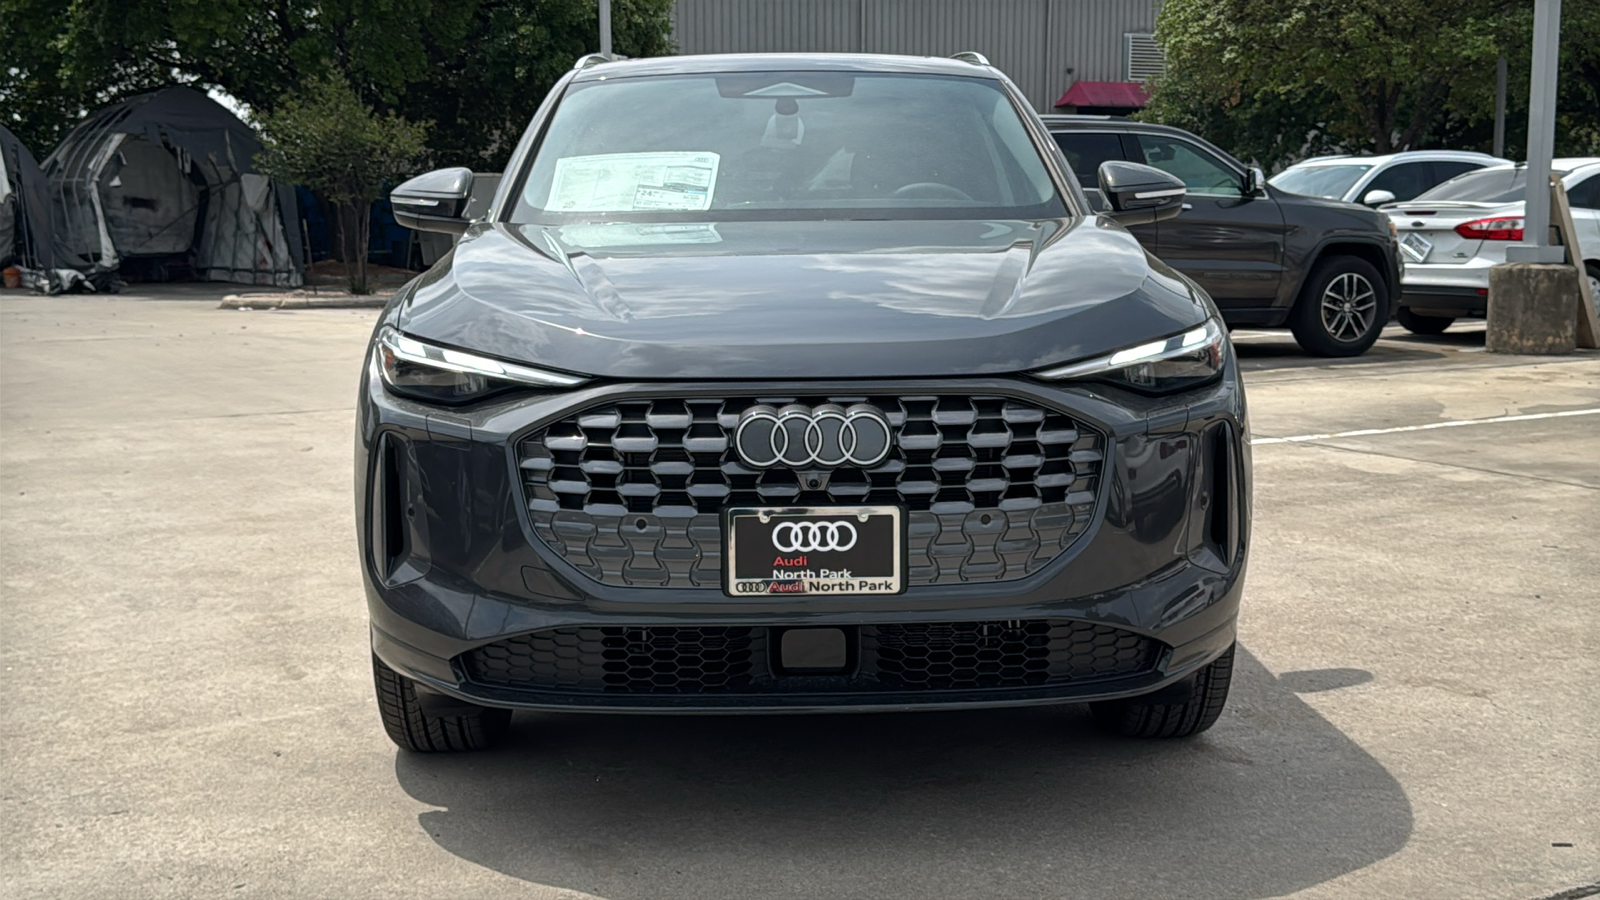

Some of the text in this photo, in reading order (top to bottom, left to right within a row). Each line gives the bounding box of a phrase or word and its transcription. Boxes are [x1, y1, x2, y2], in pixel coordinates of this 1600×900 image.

[773, 556, 808, 567] Audi
[773, 568, 852, 579] North Park
[769, 580, 894, 592] Audi North Park
